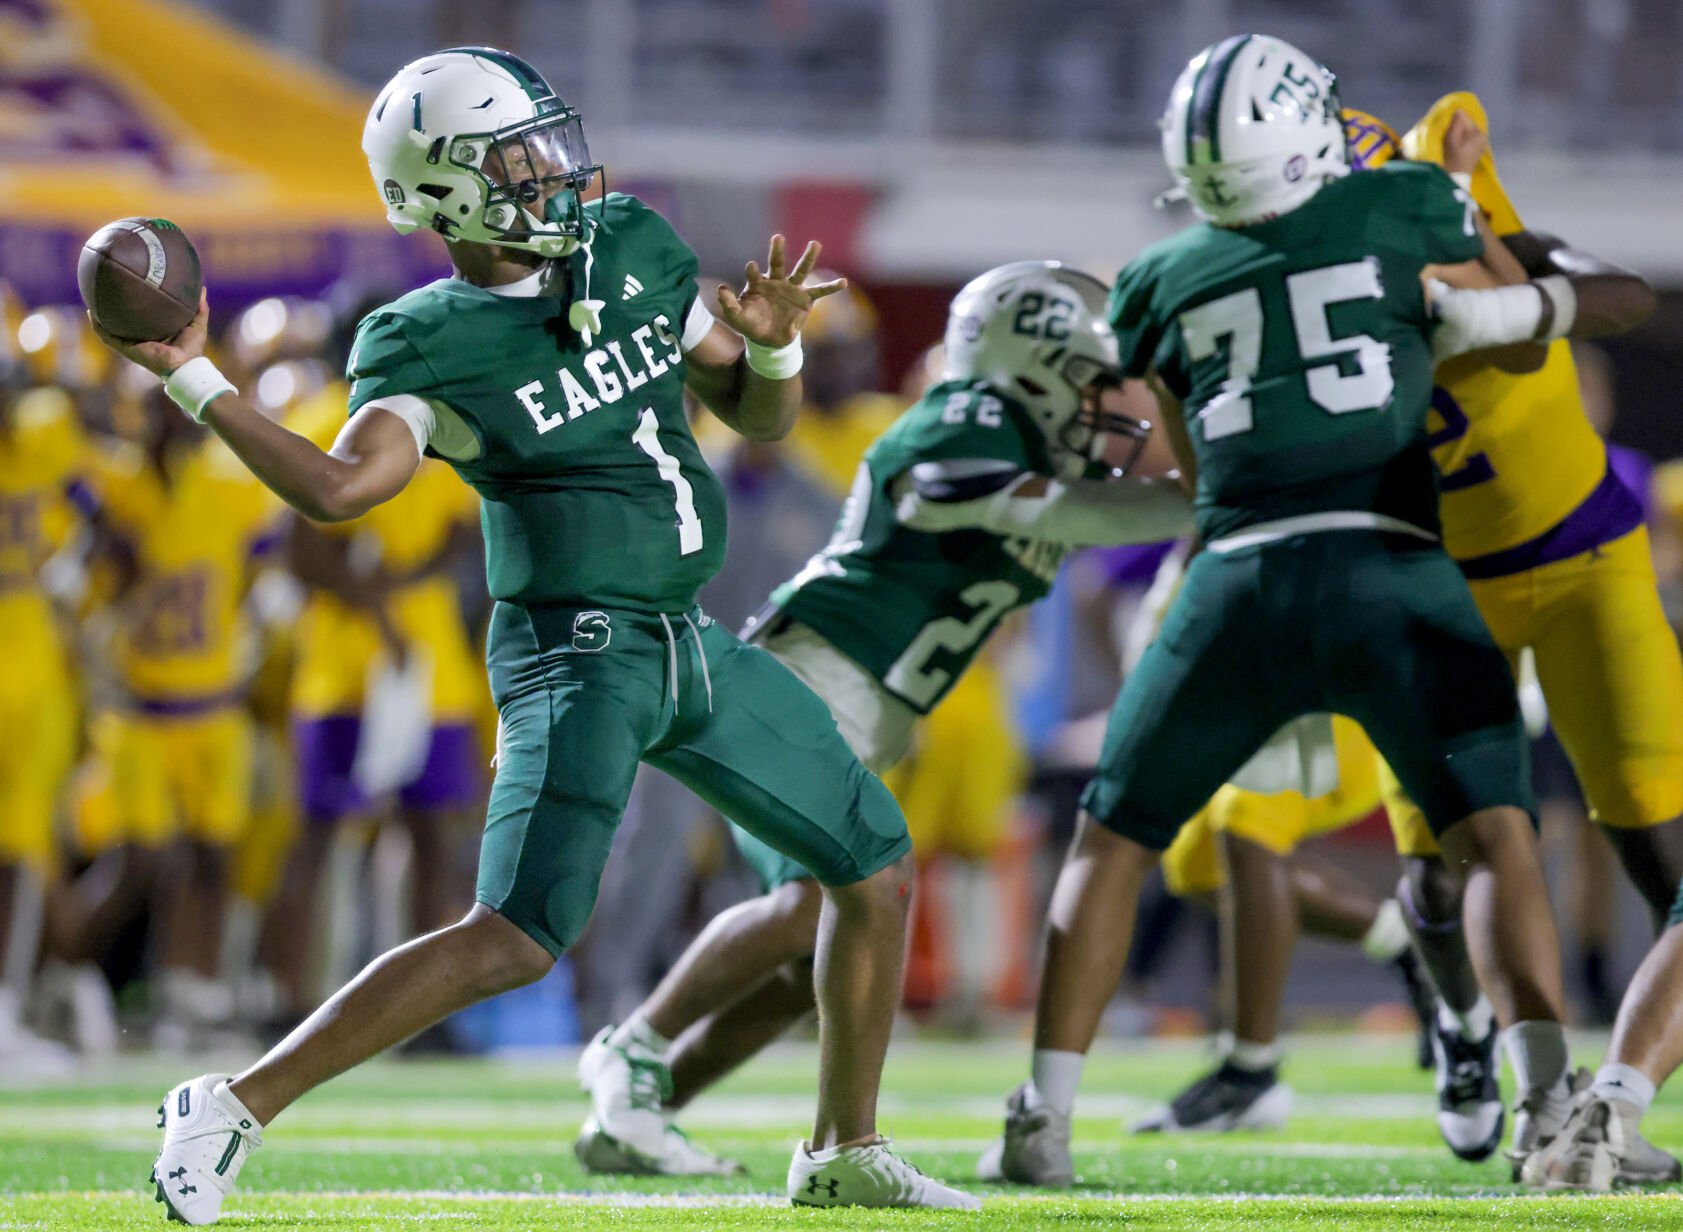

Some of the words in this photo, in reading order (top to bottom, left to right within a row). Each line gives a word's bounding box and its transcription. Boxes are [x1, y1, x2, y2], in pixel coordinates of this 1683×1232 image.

[411, 91, 425, 134] 1
[1269, 62, 1320, 123] 75
[1014, 291, 1074, 341] 22
[1179, 256, 1394, 442] 75
[514, 314, 683, 435] EAGLES
[942, 391, 1003, 428] 22
[632, 406, 704, 556] 1
[883, 580, 1021, 708] 2
